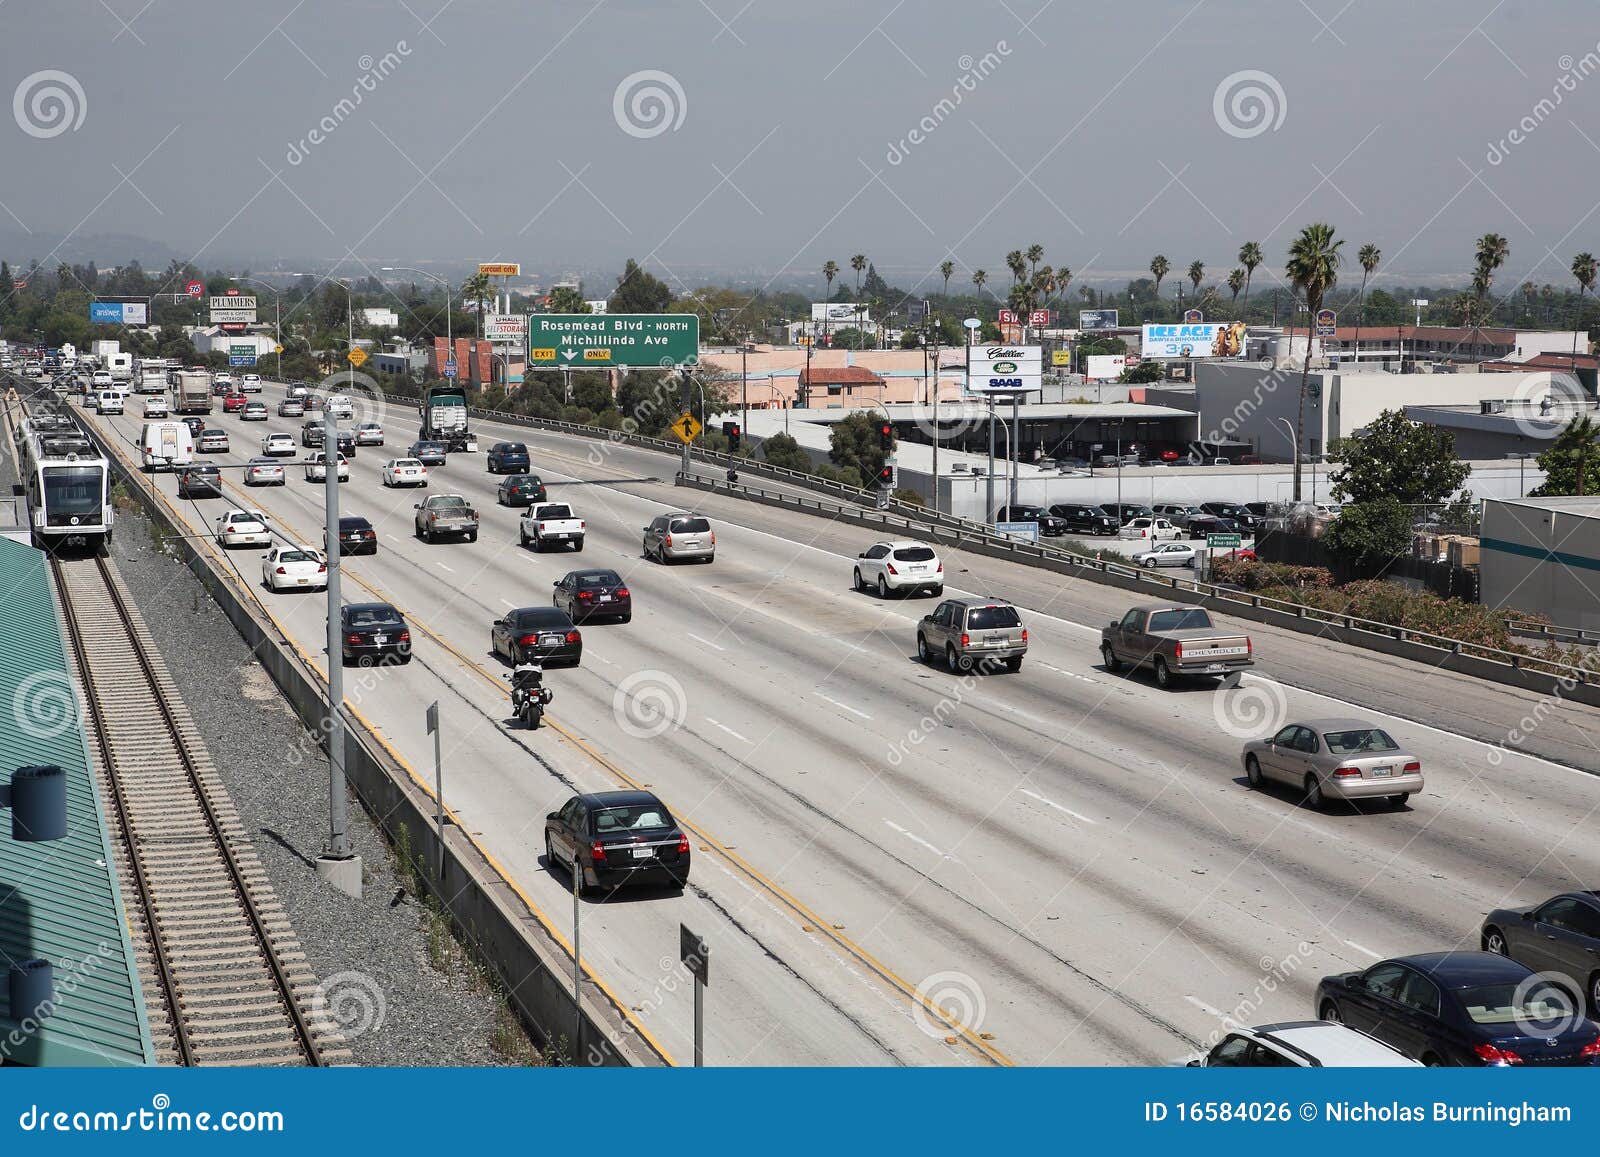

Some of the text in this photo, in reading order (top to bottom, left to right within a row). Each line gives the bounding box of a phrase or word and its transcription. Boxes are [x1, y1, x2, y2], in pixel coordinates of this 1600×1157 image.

[190, 285, 201, 293] 76
[212, 297, 255, 307] PLUMMERS
[541, 320, 605, 331] Rosemead
[614, 320, 643, 331] Blvd
[655, 322, 689, 331] NORTH
[1148, 326, 1213, 337] ICE AGE
[561, 335, 669, 345] Michillinda Ave
[986, 347, 1025, 360] Cadillac
[989, 378, 1023, 388] SAAB
[1188, 647, 1243, 657] CHEVROLET
